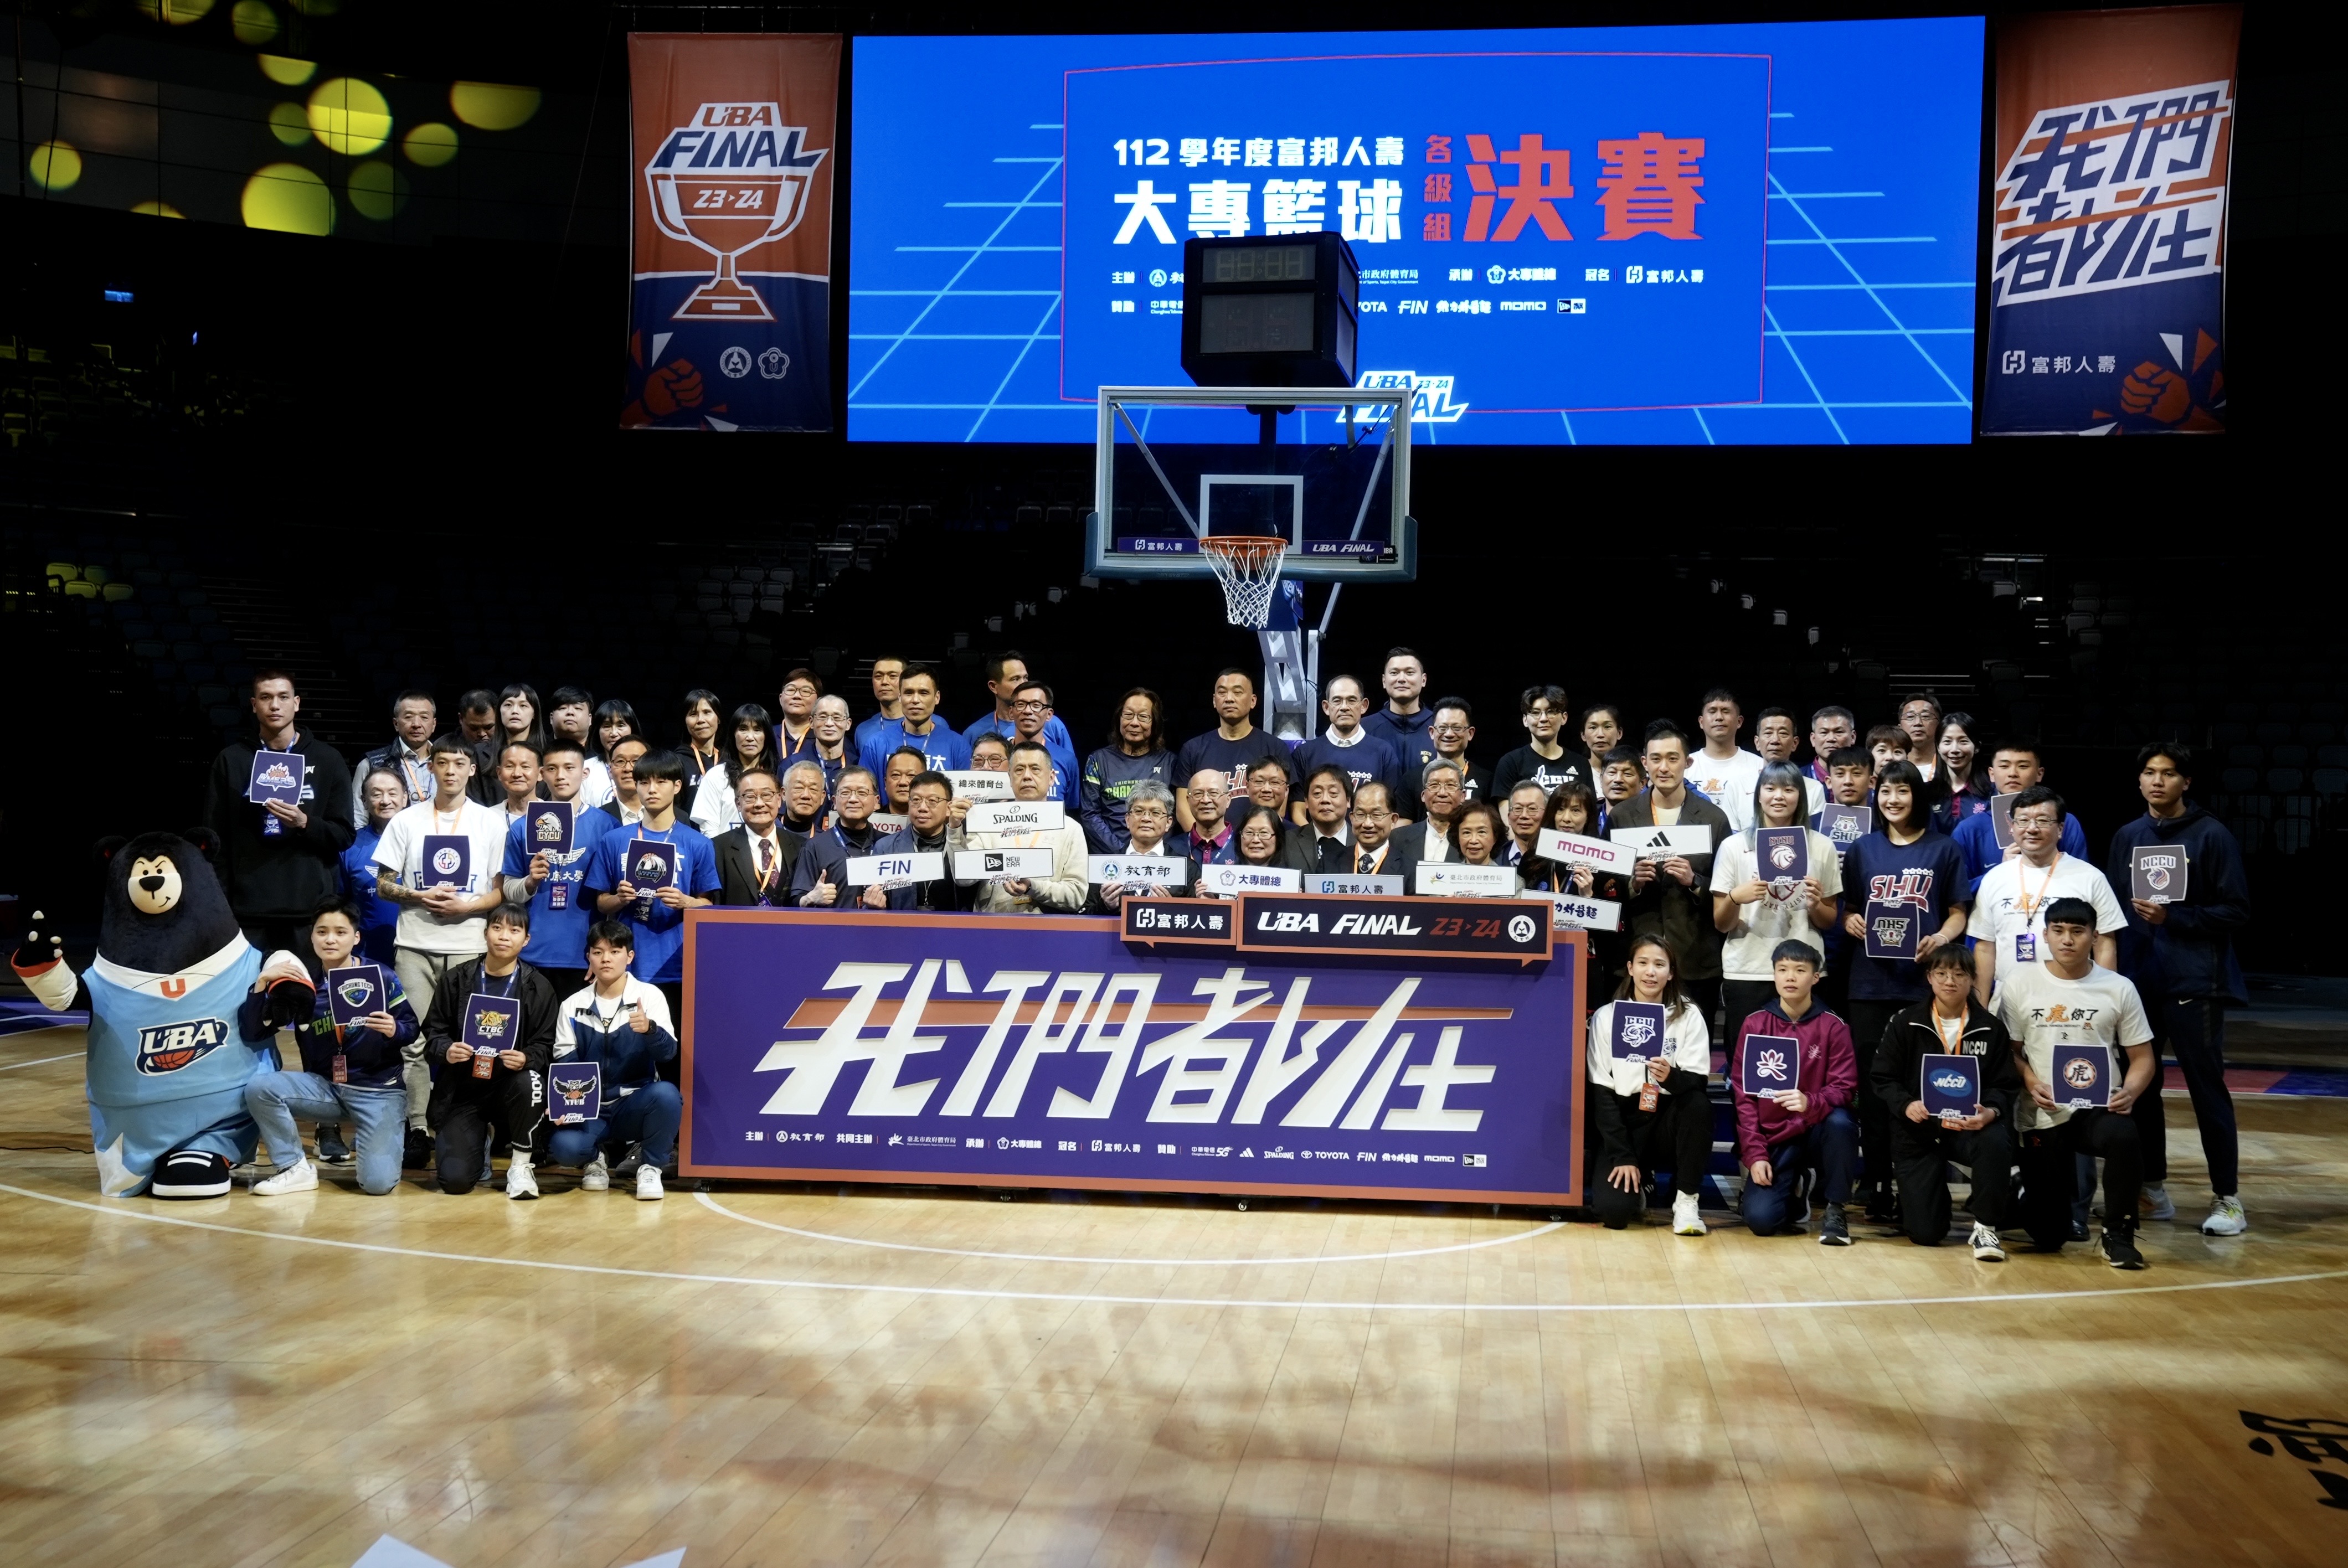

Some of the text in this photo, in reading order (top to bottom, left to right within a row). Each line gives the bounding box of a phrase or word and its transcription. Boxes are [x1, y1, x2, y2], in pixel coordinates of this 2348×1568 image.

[702, 106, 773, 126] UBA
[652, 131, 823, 168] FINAL
[1113, 136, 1404, 167] 112 學年度富邦人壽
[1423, 135, 1452, 242] 各級組
[1463, 132, 1707, 242] 決賽
[1113, 178, 1403, 244] 大專籃球
[1358, 269, 1418, 279] 市政府體育局
[1646, 270, 1703, 283] 富邦人壽
[1358, 301, 1387, 312] OTA
[1398, 300, 1428, 314] FIN
[2032, 355, 2116, 374] 富邦人壽
[1363, 375, 1412, 388] UBA
[1147, 542, 1183, 551] 富邦人壽
[1312, 544, 1375, 553] UBA FINAL
[959, 779, 1003, 789] 緯來體育台
[993, 813, 1038, 824] SPALDING
[538, 831, 561, 840] CYCU
[1769, 835, 1794, 846] NTNU
[1557, 840, 1615, 862] momo
[877, 859, 912, 876] FIN
[2143, 857, 2174, 868] NCCU
[1124, 865, 1171, 878] 教育部
[1238, 874, 1281, 886] 大專體總
[1338, 884, 1383, 894] 富邦人壽
[1869, 874, 1933, 900] SHU
[1157, 913, 1224, 931] 富邦人壽
[1257, 911, 1320, 932] UBA
[1330, 914, 1422, 936] FINAL
[160, 978, 186, 998] U
[2031, 1004, 2099, 1023] 不虎你了
[1626, 1017, 1654, 1026] CCU
[479, 1025, 503, 1034] CTBC
[143, 1022, 217, 1054] UBA
[1963, 1040, 1987, 1055] NCCU
[2068, 1064, 2092, 1082] 虎
[1933, 1074, 1967, 1088] NCCU
[745, 1131, 764, 1141] 主辦
[790, 1132, 825, 1142] 教育部
[836, 1133, 873, 1144] 共同主辦
[1058, 1141, 1077, 1151] 冠名
[1104, 1143, 1141, 1153] 富邦人壽
[1264, 1150, 1294, 1160] SPALDING
[1315, 1151, 1350, 1160] TOYOTA
[1357, 1152, 1377, 1162] FIN
